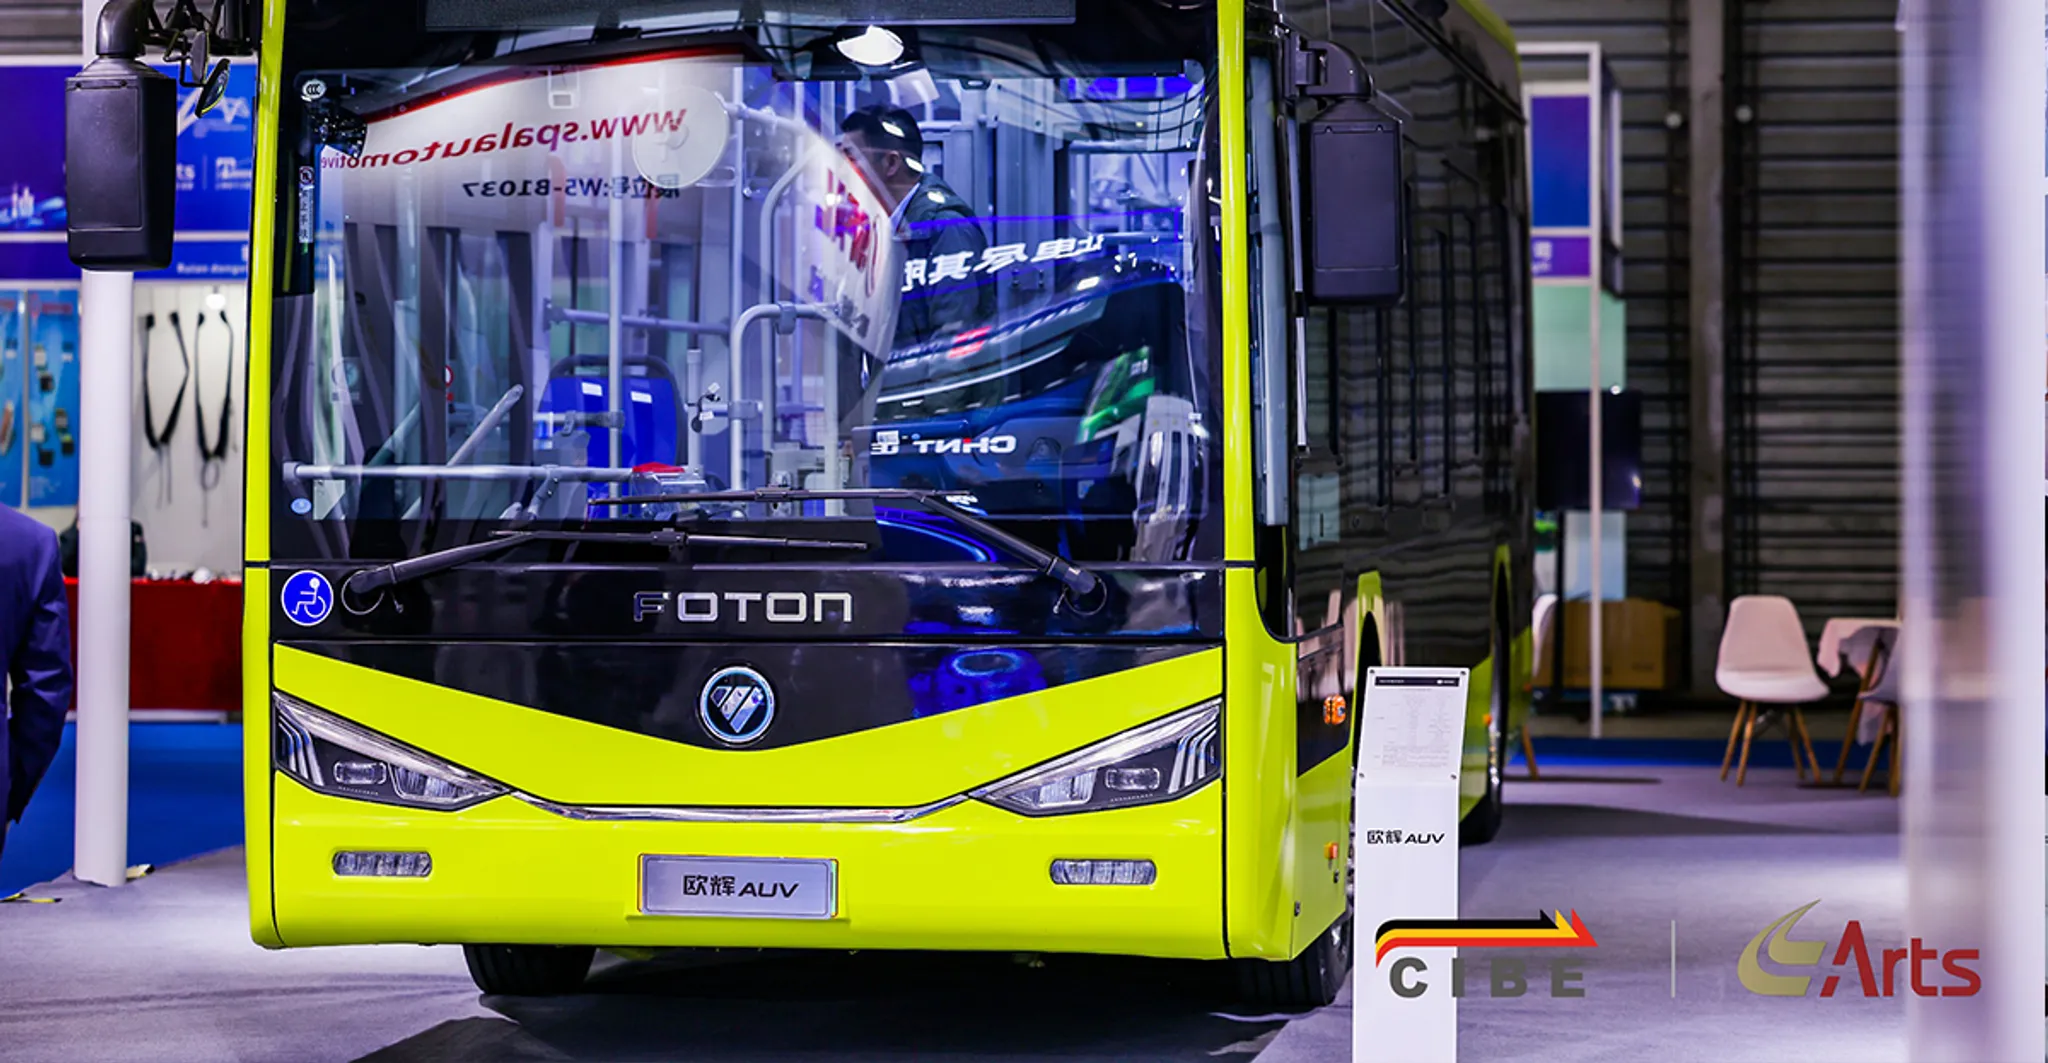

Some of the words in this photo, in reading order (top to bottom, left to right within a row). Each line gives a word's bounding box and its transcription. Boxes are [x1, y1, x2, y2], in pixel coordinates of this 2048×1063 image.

[633, 591, 852, 622] FOTON
[1367, 829, 1402, 844] 欧辉
[1404, 833, 1446, 844] AUV
[683, 874, 736, 897] 欧辉
[738, 882, 799, 898] AUV
